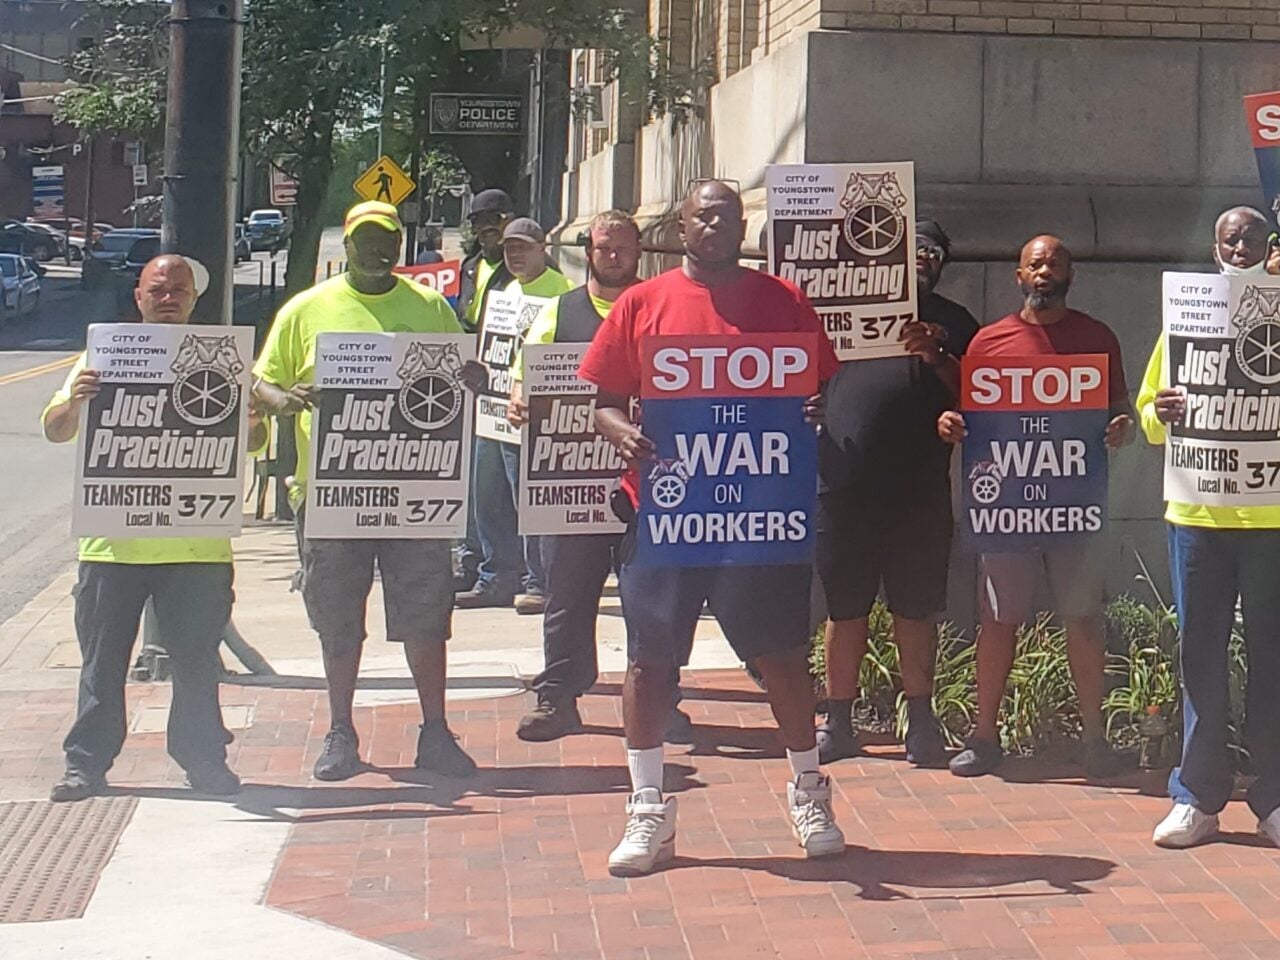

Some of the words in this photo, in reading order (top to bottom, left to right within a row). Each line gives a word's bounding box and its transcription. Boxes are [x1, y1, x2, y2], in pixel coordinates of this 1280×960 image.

[460, 108, 516, 120] POLICE
[785, 175, 806, 183] CITY
[773, 186, 835, 194] YOUNGSTOWN
[785, 224, 840, 261] Just
[1181, 285, 1199, 295] CITY
[1201, 287, 1213, 295] OF
[1169, 297, 1228, 309] YOUNGSTOWN
[1181, 311, 1212, 321] STREET
[112, 335, 134, 343] CITY
[1170, 324, 1226, 335] DEPARTMENT
[95, 346, 167, 355] YOUNGSTOWN
[338, 343, 361, 351] CITY
[364, 343, 377, 351] OF
[110, 359, 149, 367] STREET
[321, 354, 392, 362] YOUNGSTOWN
[529, 363, 580, 371] YOUNGSTO
[1178, 342, 1231, 386] Just
[97, 371, 164, 379] DEPARTMENT
[337, 366, 375, 374] STREET
[652, 347, 808, 391] STOP
[322, 378, 389, 386] DEPARTMENT
[970, 367, 1101, 404] STOP
[101, 388, 168, 427] Just
[331, 393, 395, 431] Just
[540, 399, 597, 434] Just
[711, 405, 747, 424] THE
[1020, 417, 1050, 434] THE
[89, 428, 235, 476] Practicing
[320, 433, 459, 478] Practicing
[531, 435, 628, 472] Practic
[675, 432, 789, 477] WAR
[990, 440, 1086, 477] WAR
[1170, 443, 1239, 472] TEAMSTERS
[714, 484, 742, 504] ON
[1023, 484, 1047, 501] ON
[1198, 476, 1220, 493] Local
[1224, 478, 1241, 495] No.
[83, 485, 172, 507] TEAMSTERS
[315, 486, 400, 507] TEAMSTERS
[528, 485, 606, 506] TEAMSTERS
[126, 511, 152, 527] Local
[156, 511, 172, 527] No.
[177, 494, 236, 519] 377
[356, 512, 381, 527] Local
[384, 512, 400, 527] No.
[405, 499, 464, 523] 377
[566, 510, 590, 523] Local
[593, 510, 608, 523] No.
[969, 506, 1101, 534] WORKERS
[647, 510, 807, 544] WORKERS
